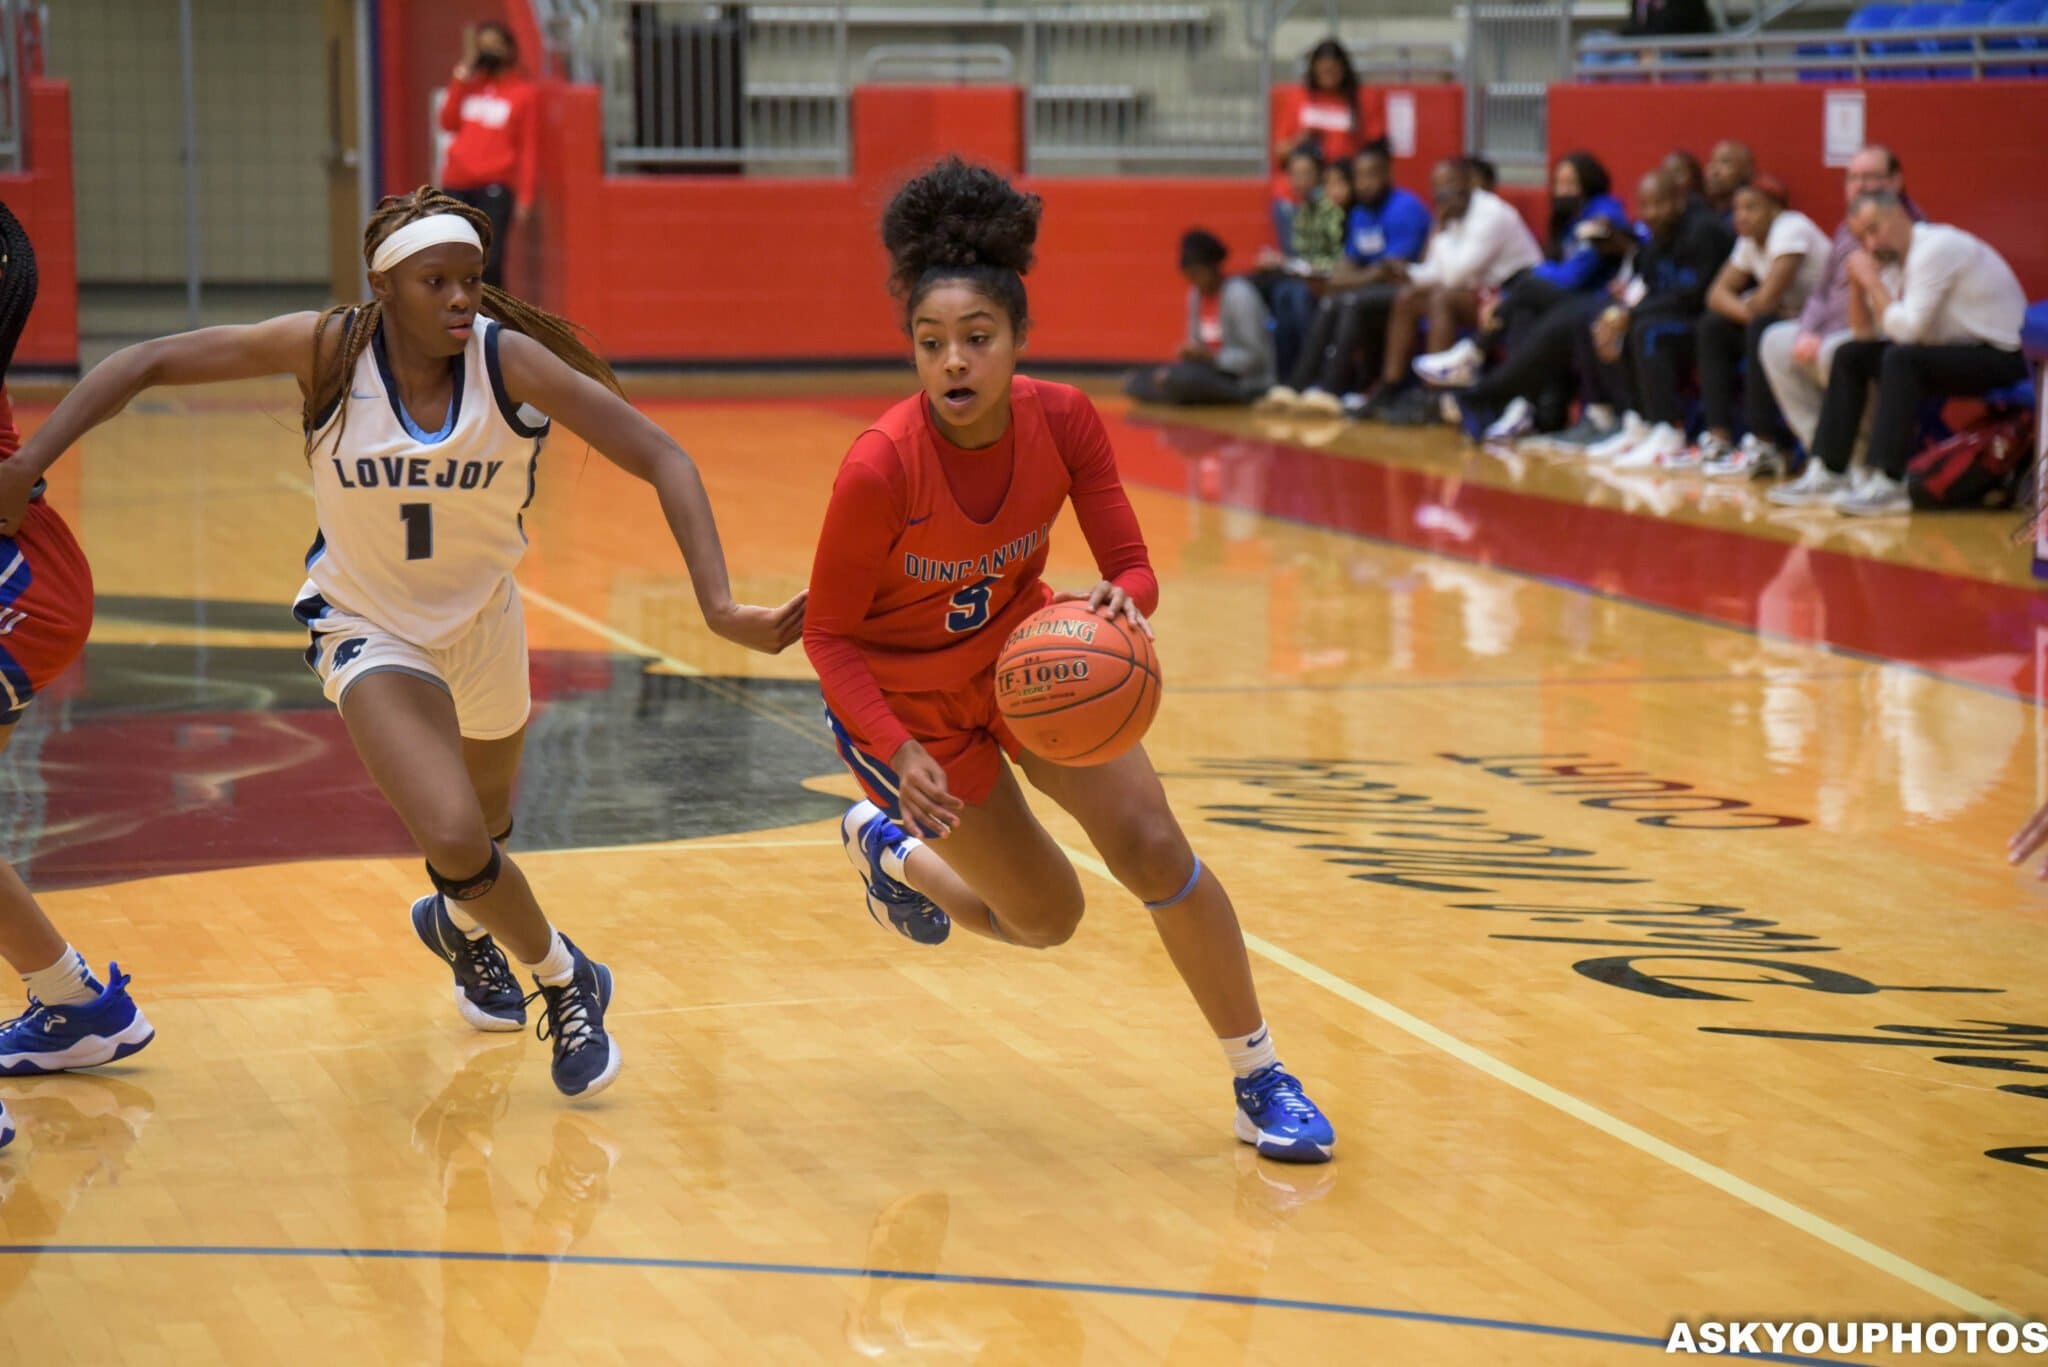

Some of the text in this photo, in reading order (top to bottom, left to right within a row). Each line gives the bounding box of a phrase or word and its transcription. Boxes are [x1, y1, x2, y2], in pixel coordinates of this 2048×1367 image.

[332, 456, 504, 490] LOVEJOY
[400, 503, 433, 561] 1
[998, 659, 1089, 693] TF-1000
[1435, 752, 1811, 829] COURT
[1443, 901, 2007, 1001] Phil
